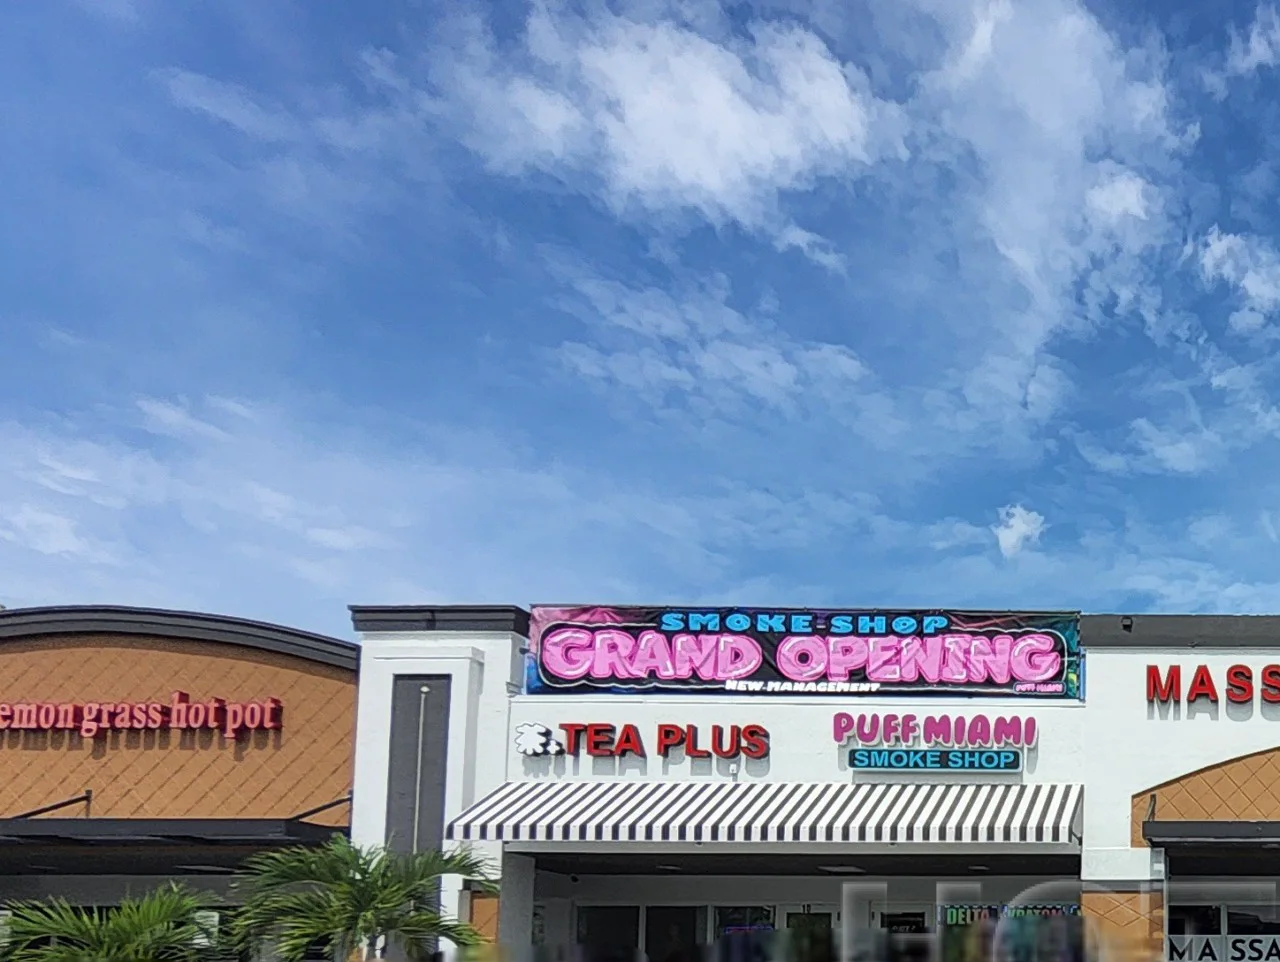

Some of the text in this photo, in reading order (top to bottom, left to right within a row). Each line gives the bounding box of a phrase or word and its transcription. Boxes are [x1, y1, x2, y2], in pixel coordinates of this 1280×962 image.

[660, 613, 949, 634] SMOKE SHOP
[541, 629, 1061, 684] GRAND OPENING
[725, 680, 880, 692] NEW MANAGEMENT
[80, 700, 164, 738] grass
[168, 691, 226, 730] hot
[224, 697, 283, 740] pot
[834, 713, 1037, 747] PUFF MIAMI
[560, 722, 771, 759] TEA PLUS
[853, 750, 1016, 769] SMOKE SHOP
